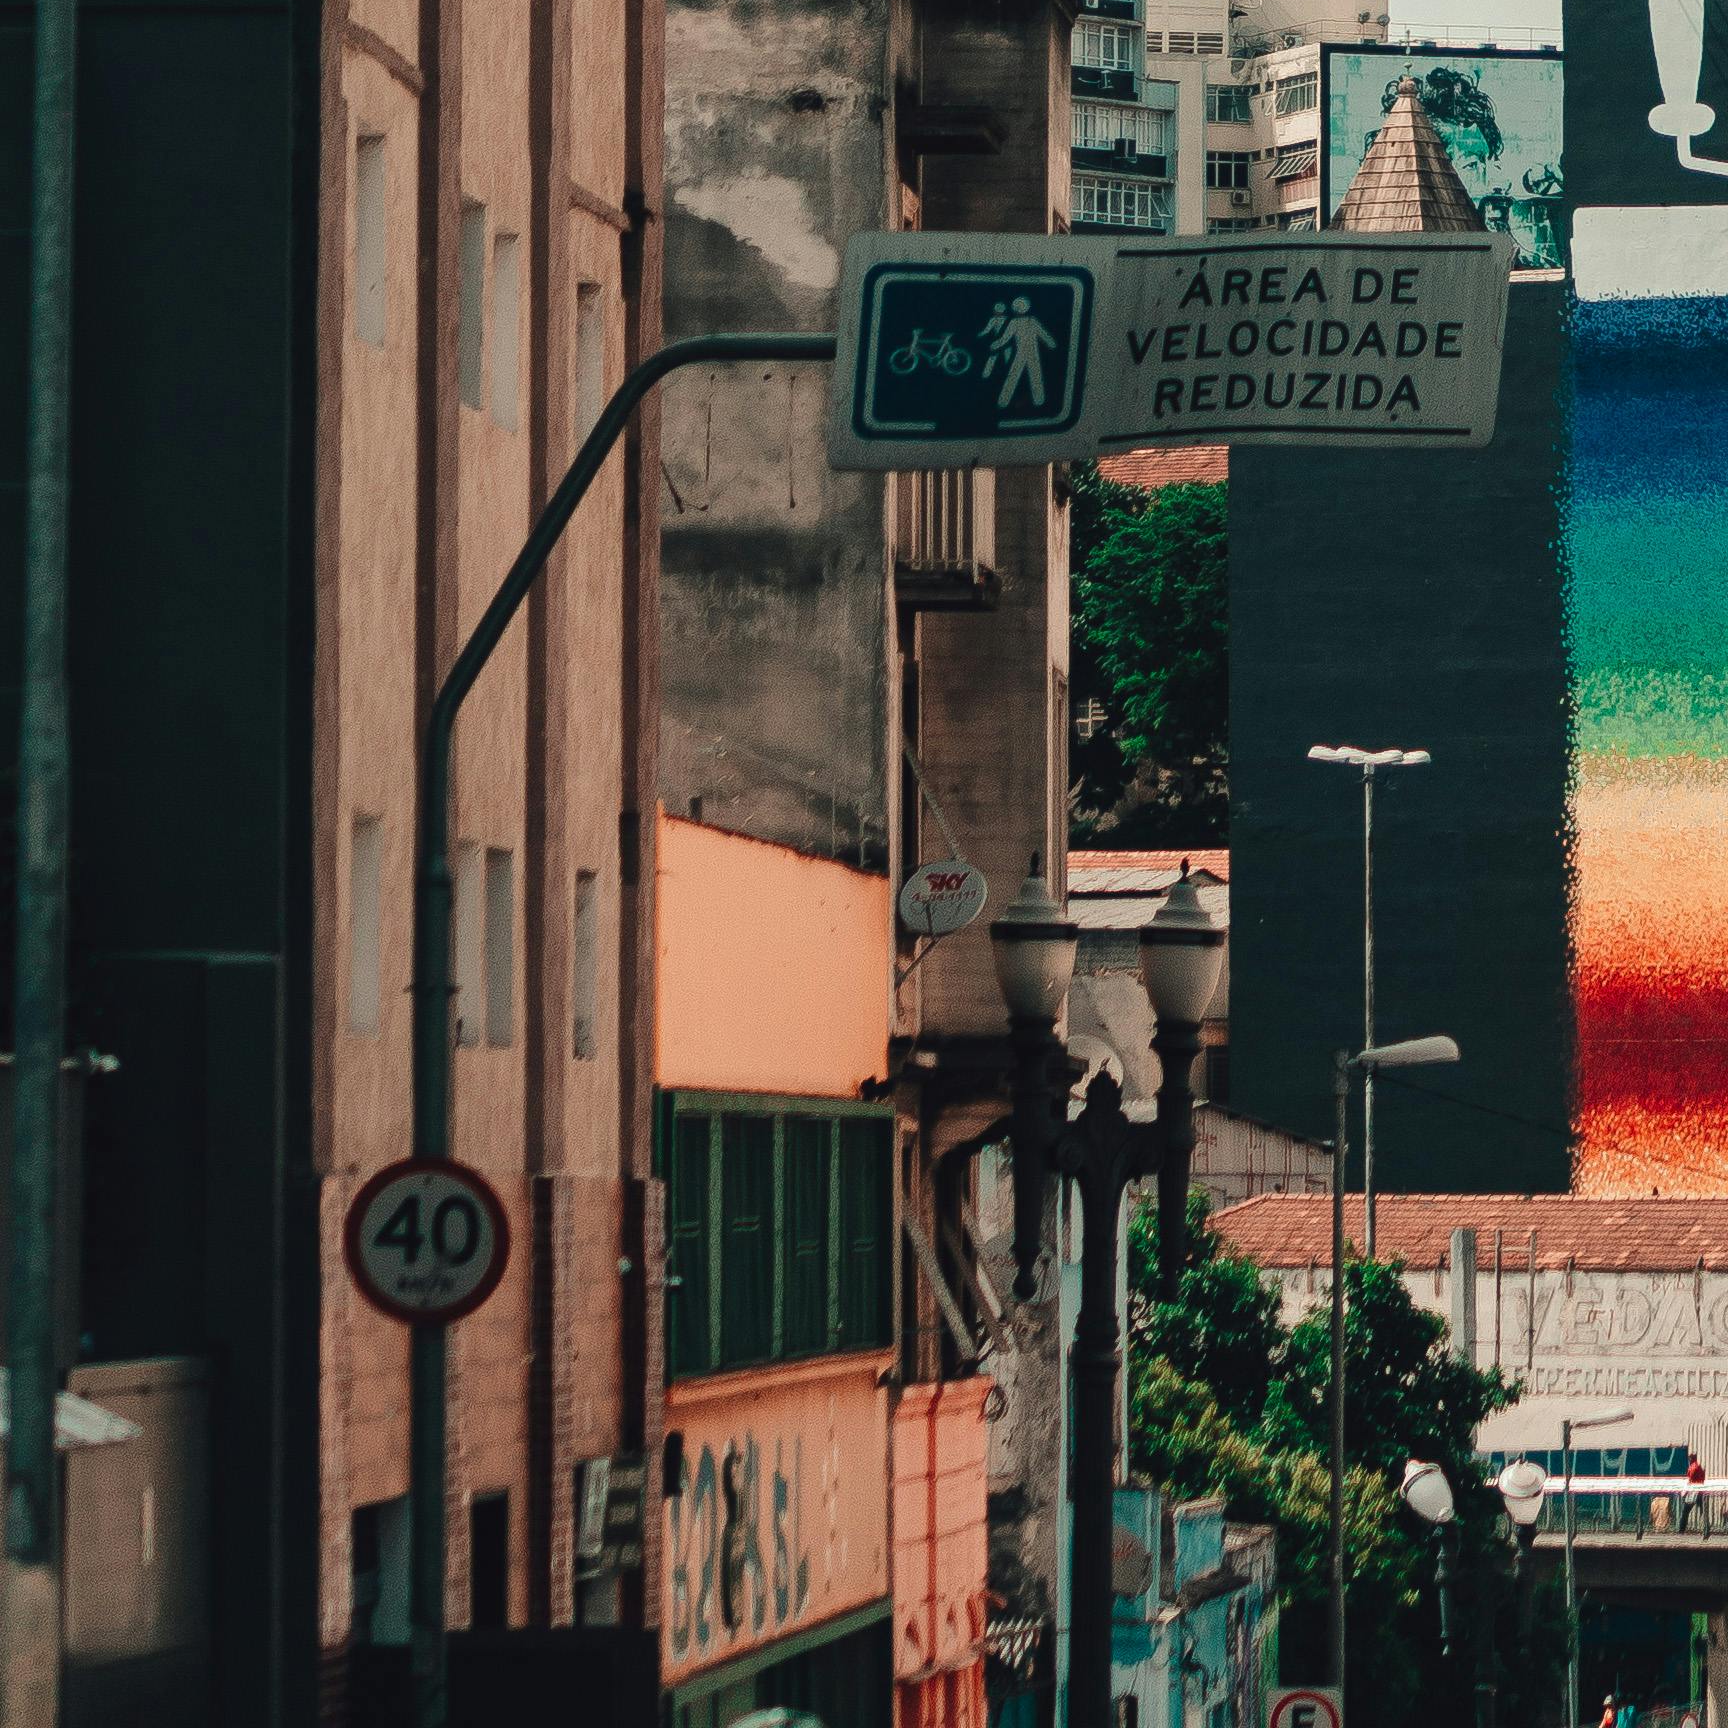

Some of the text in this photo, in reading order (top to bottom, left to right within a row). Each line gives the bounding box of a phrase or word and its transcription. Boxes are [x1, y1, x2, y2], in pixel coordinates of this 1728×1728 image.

[1178, 258, 1420, 309] ÁREA DE
[1126, 319, 1464, 365] VELOCIDADE
[1153, 373, 1421, 416] REDUZIDA
[373, 1195, 481, 1268] 40
